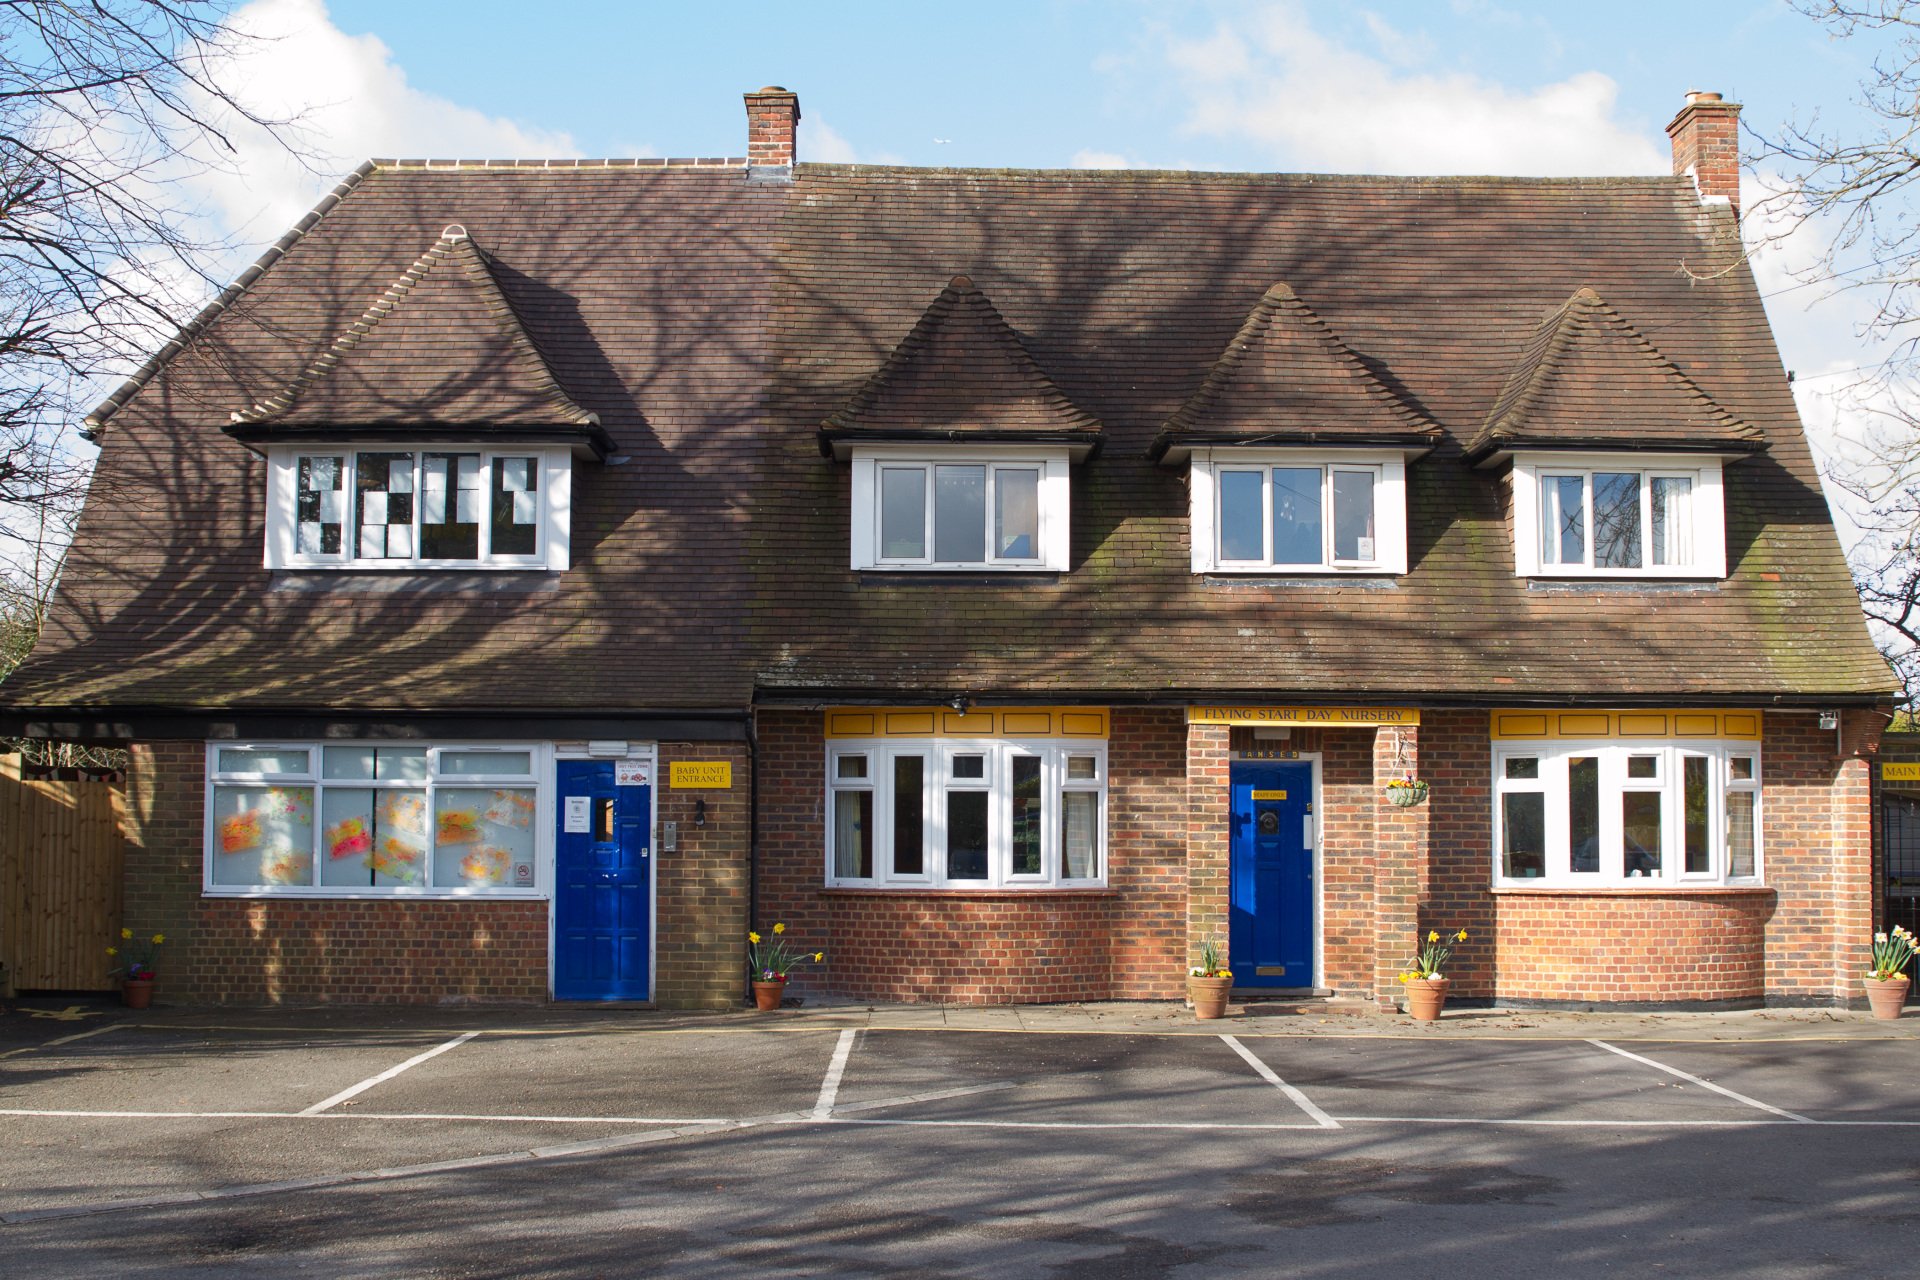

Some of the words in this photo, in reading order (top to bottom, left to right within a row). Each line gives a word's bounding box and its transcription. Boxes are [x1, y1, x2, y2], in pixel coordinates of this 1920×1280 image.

[1204, 708, 1251, 719] FLYING
[1258, 709, 1299, 720] START
[1306, 709, 1333, 720] DAY
[1340, 709, 1405, 721] NURSERY
[1885, 767, 1916, 776] MAIN
